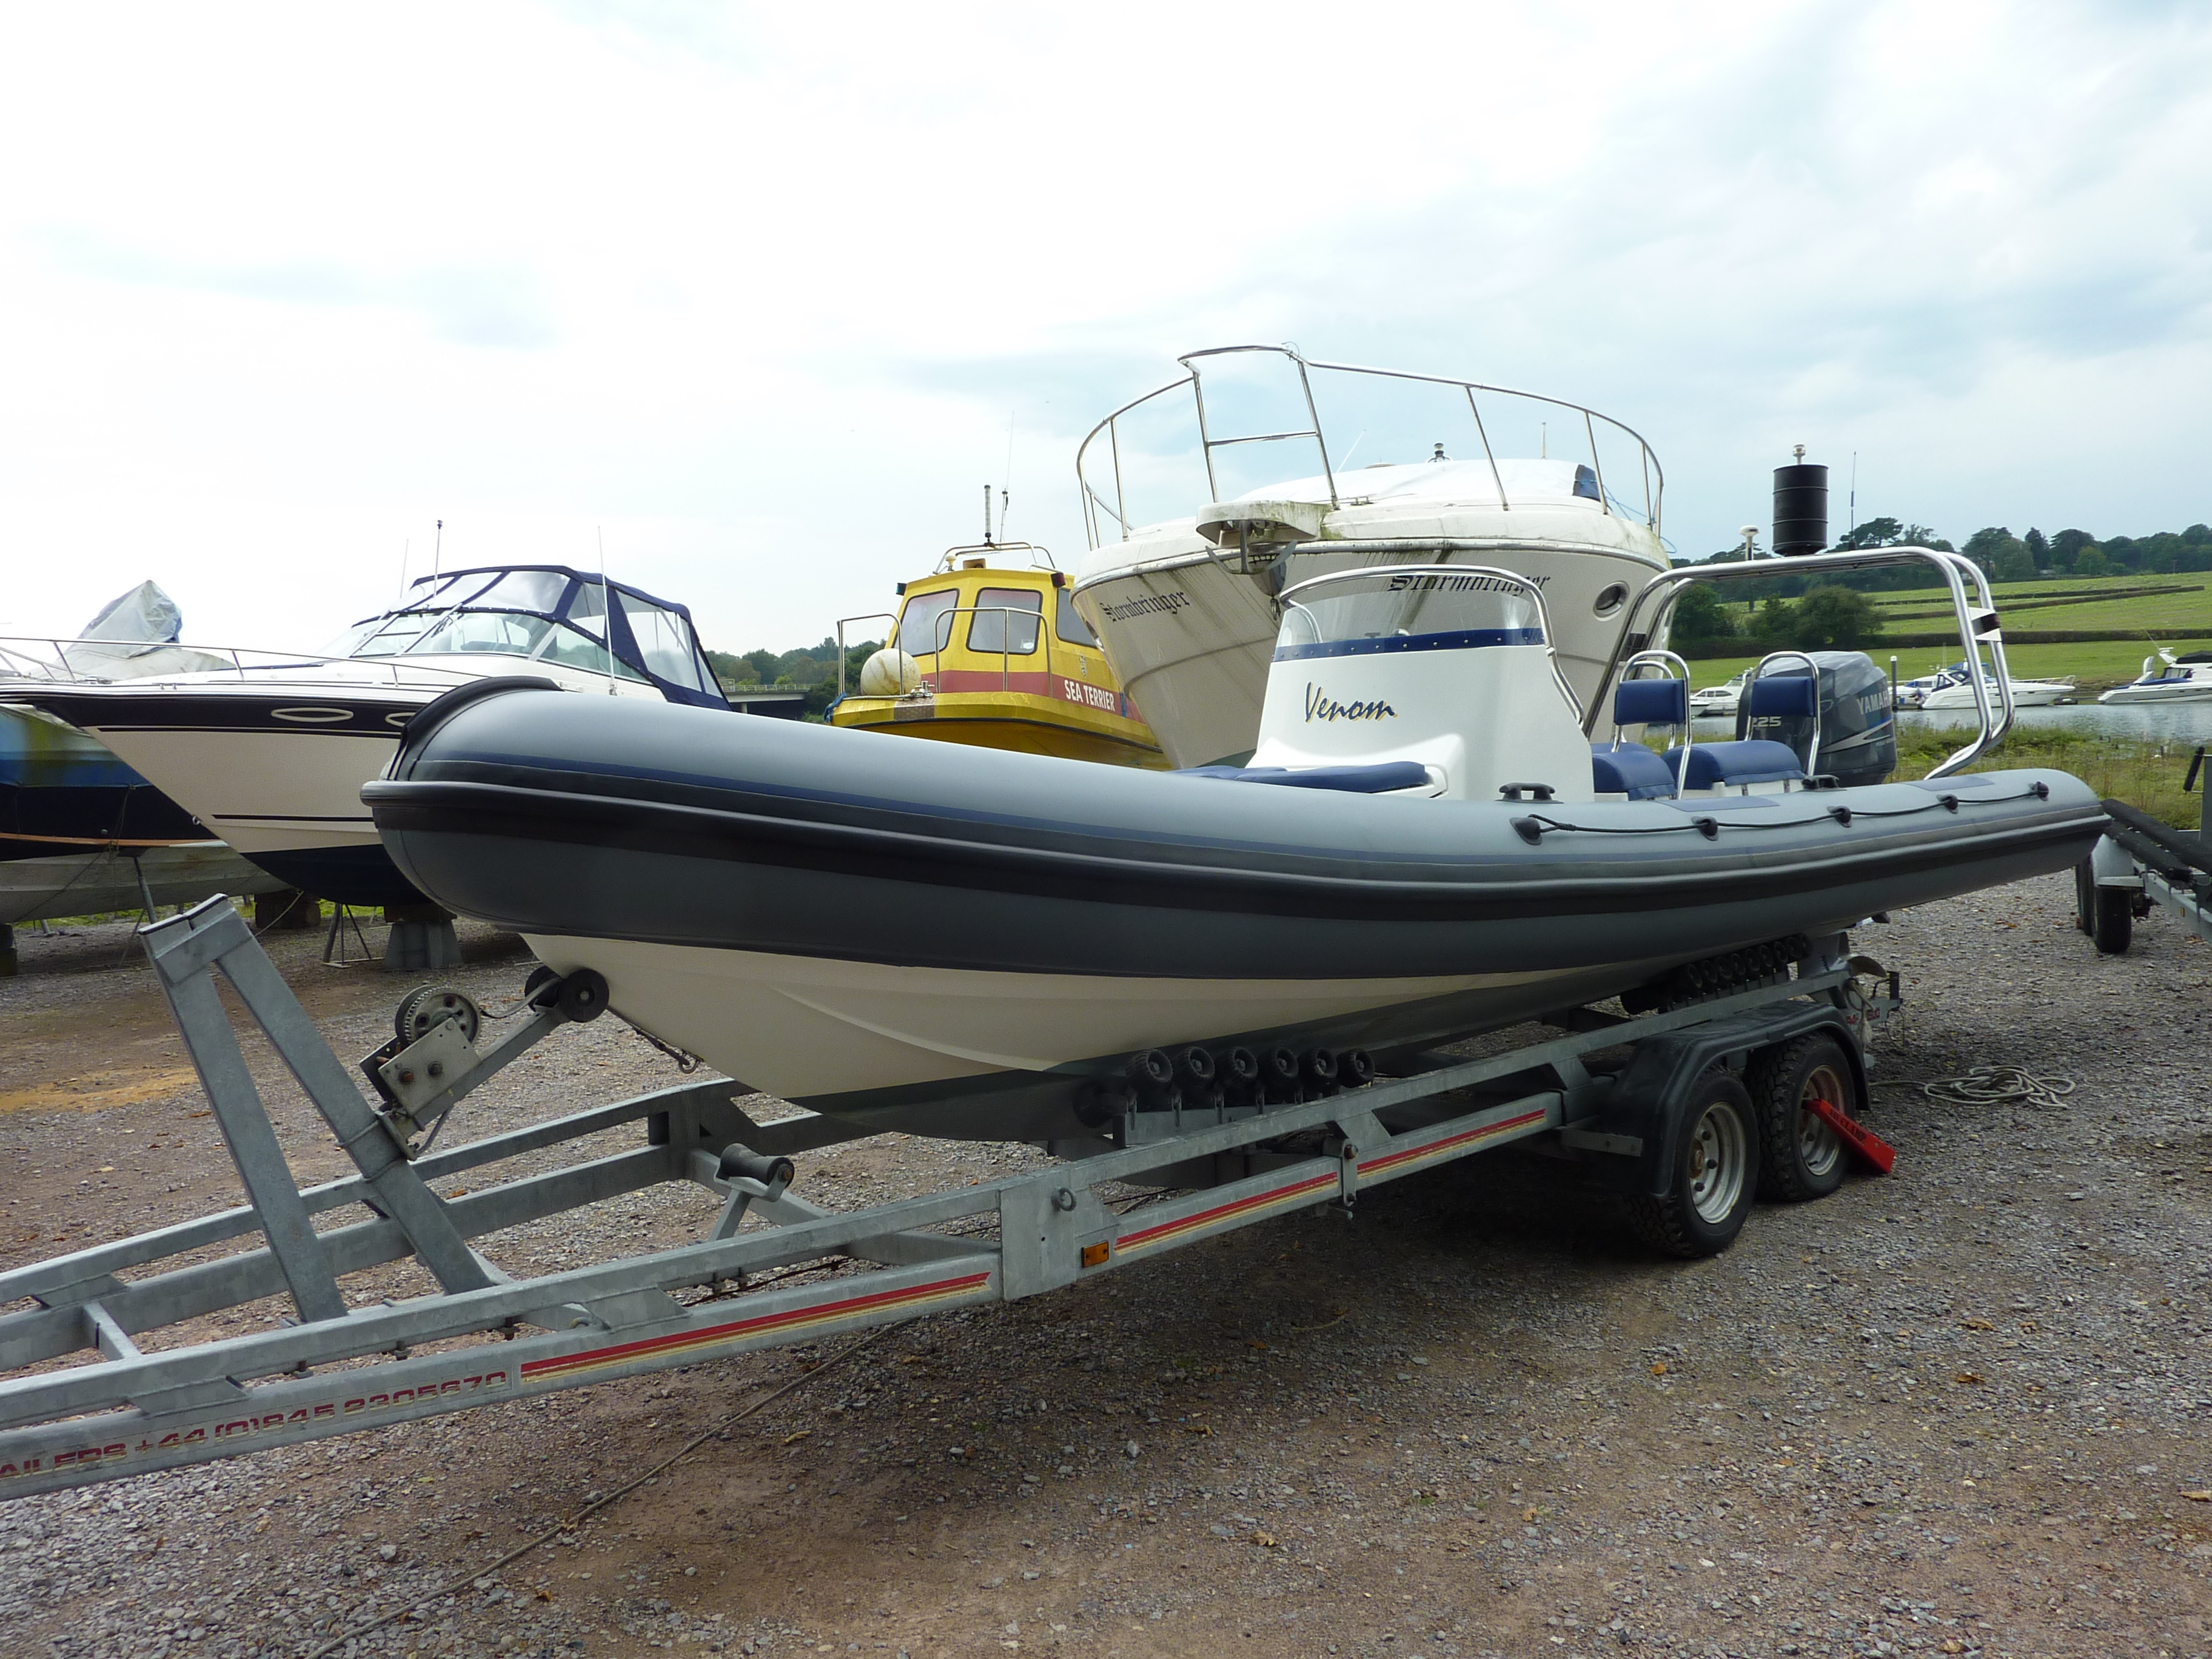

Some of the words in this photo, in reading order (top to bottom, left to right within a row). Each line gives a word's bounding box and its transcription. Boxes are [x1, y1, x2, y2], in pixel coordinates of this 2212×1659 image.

[1099, 590, 1190, 623] Stormbringer
[1064, 679, 1083, 703] SEA
[1083, 685, 1116, 712] TERRIER
[1305, 681, 1398, 723] Venom
[1856, 689, 1890, 715] YAMAH
[135, 1427, 209, 1454] +44
[344, 1370, 506, 1416] 2305670
